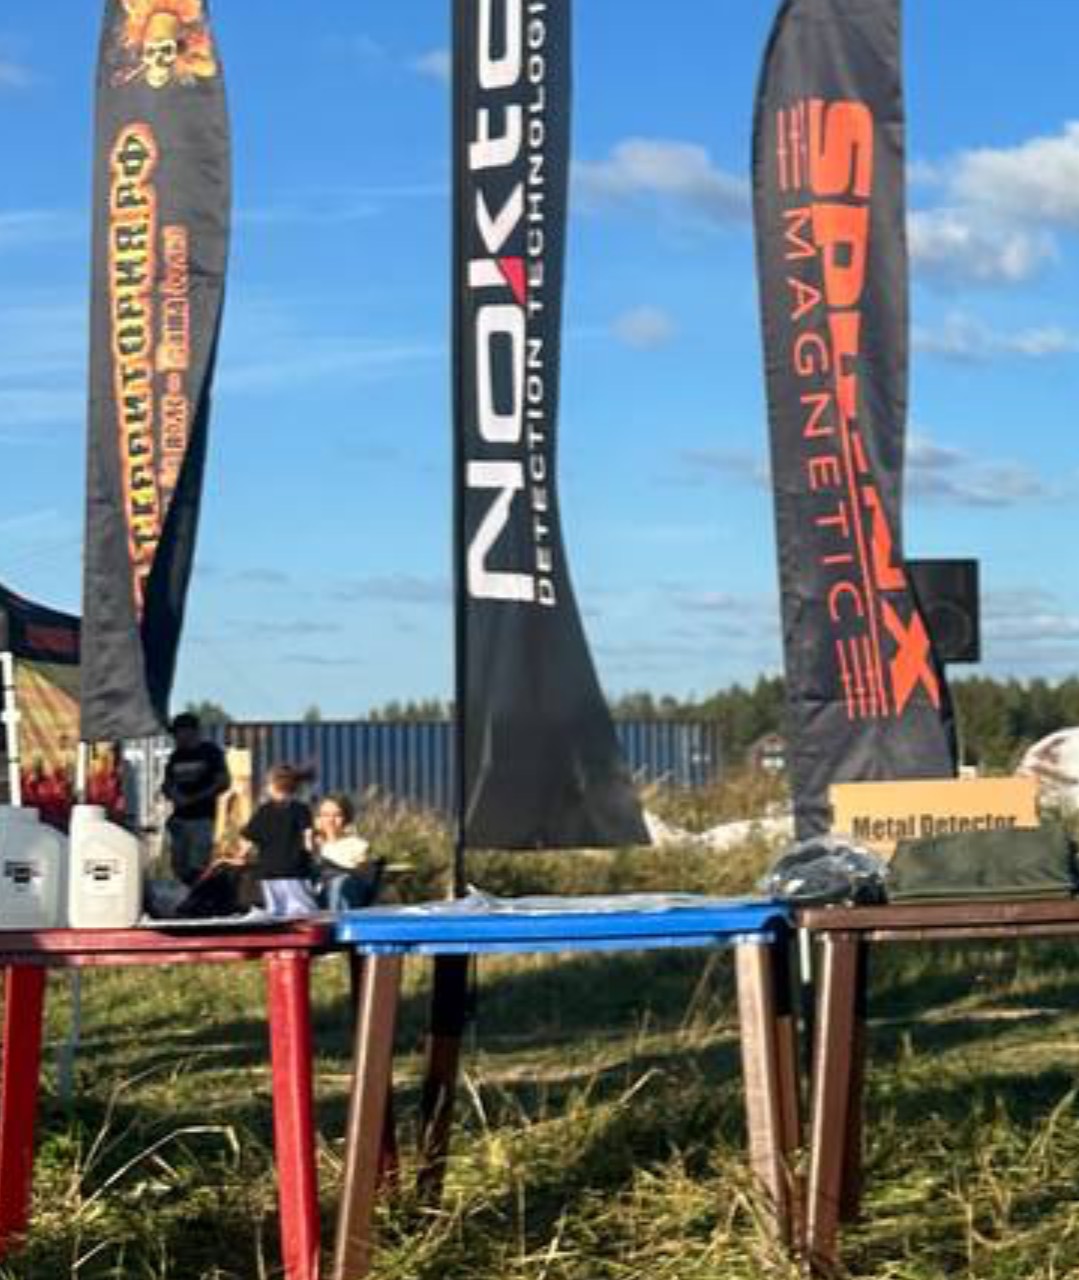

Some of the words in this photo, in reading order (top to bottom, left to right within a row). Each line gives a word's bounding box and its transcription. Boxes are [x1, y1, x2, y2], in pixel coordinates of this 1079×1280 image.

[527, 337, 556, 605] DETECTION
[782, 206, 864, 620] MAGNETIC
[852, 814, 915, 840] Metal
